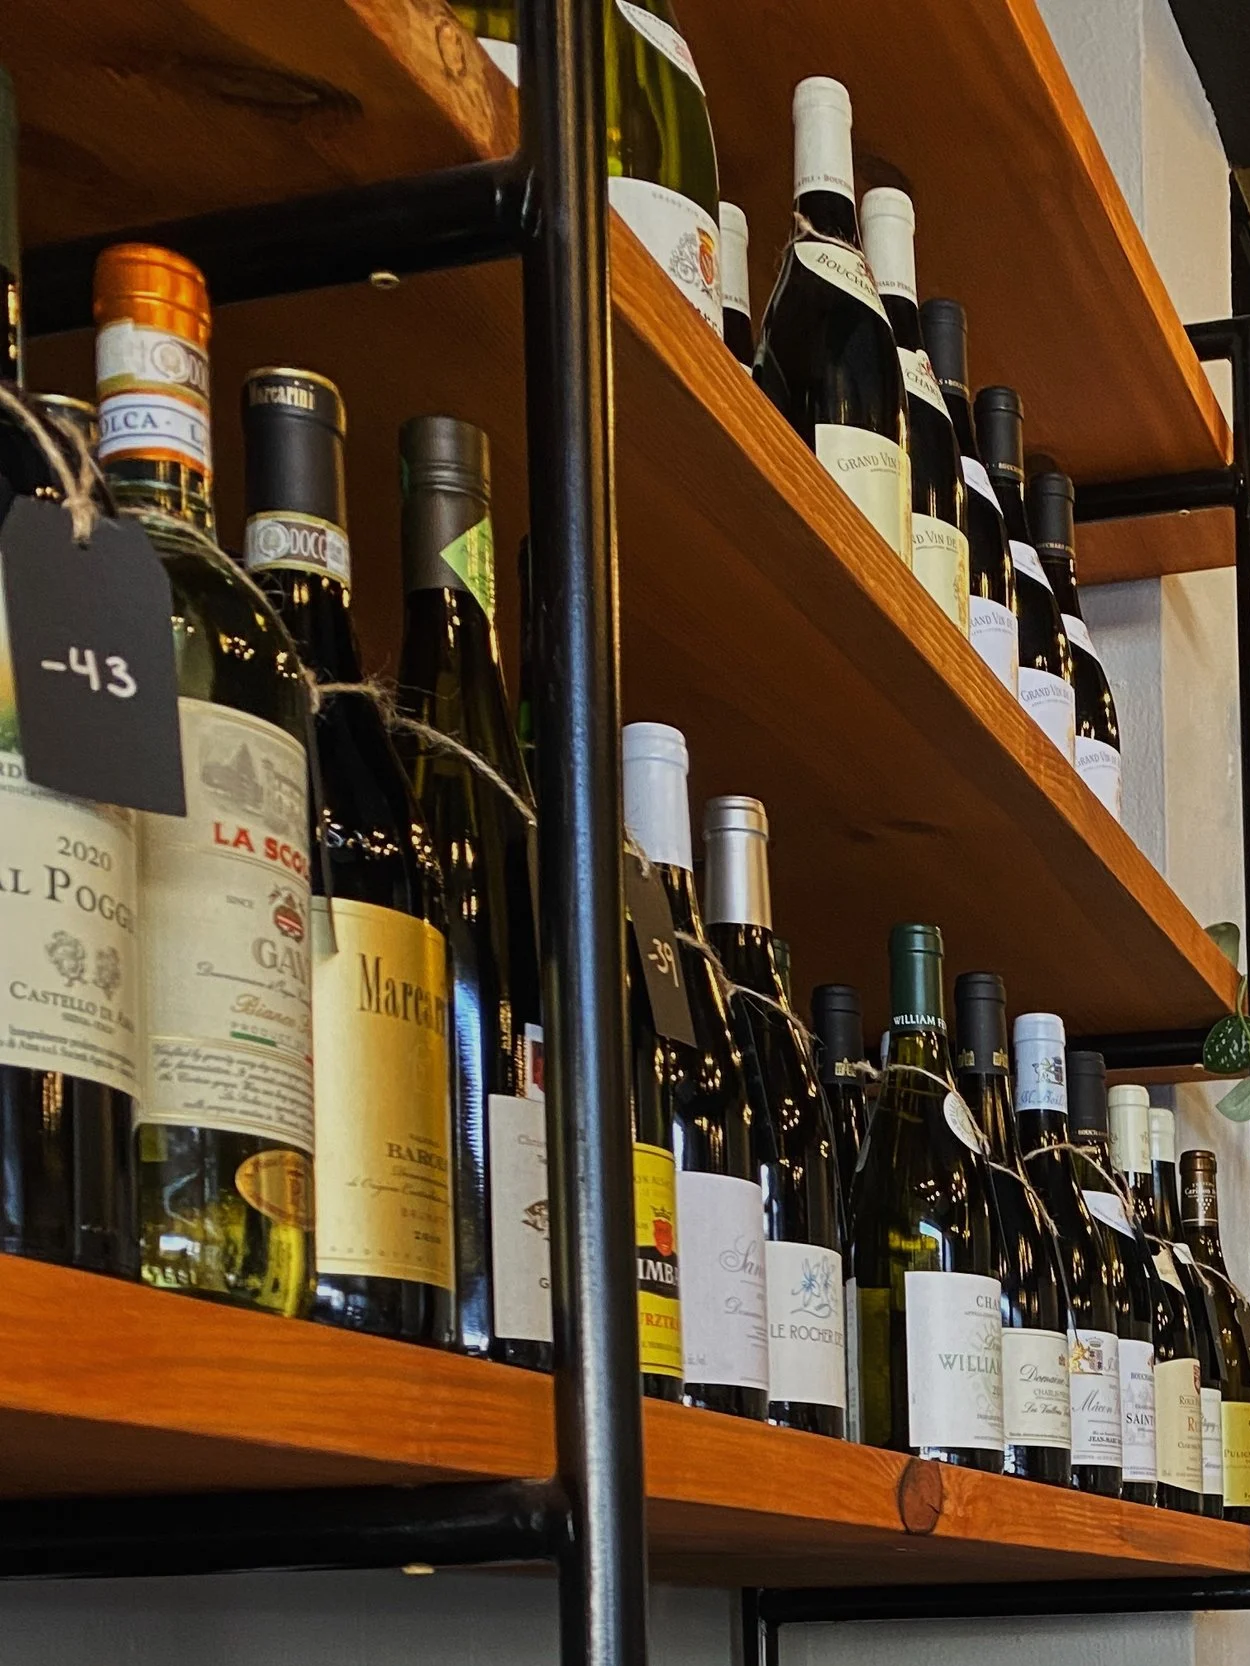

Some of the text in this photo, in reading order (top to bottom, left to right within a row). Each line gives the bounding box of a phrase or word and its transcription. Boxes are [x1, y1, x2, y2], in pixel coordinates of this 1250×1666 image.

[41, 646, 137, 698] -43
[213, 822, 255, 853] LA
[57, 836, 112, 873] 2020
[648, 938, 679, 988] -39
[893, 1013, 936, 1026] WILLIAM
[636, 1257, 678, 1286] IMB
[975, 1295, 1001, 1311] CHA
[770, 1323, 786, 1339] LE
[790, 1324, 834, 1345] ROCHER
